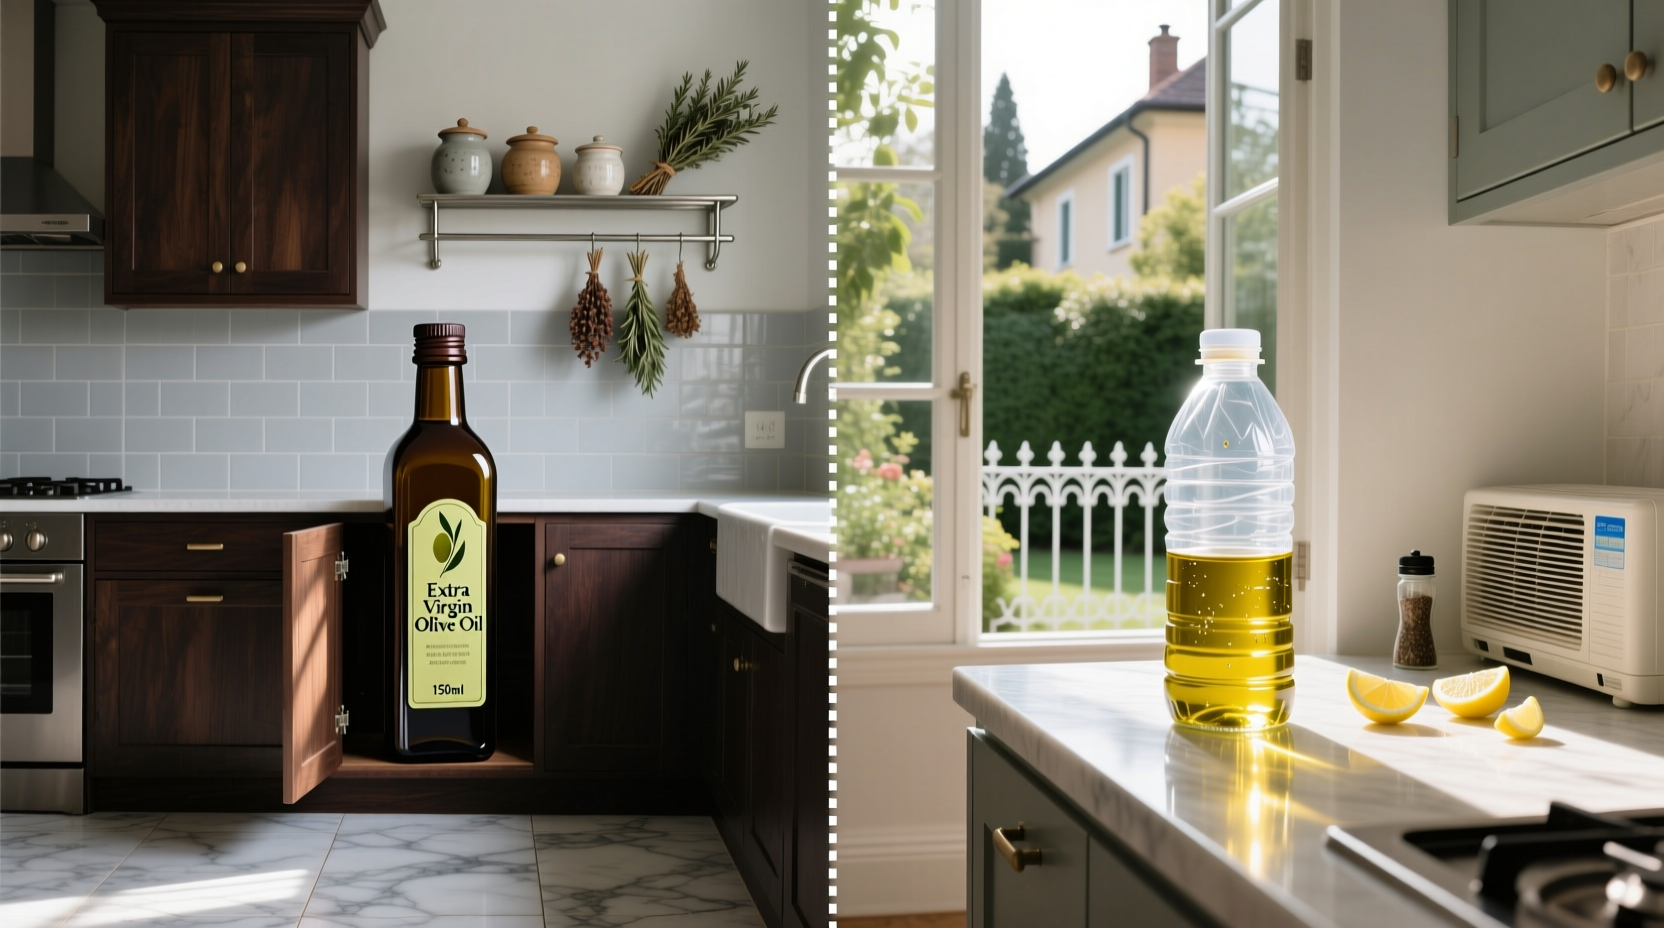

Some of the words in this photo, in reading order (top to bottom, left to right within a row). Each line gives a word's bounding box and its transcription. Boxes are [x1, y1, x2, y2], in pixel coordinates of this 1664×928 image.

[427, 582, 470, 598] Extra
[423, 599, 473, 619] Virgin
[414, 616, 456, 632] Olive
[459, 615, 483, 632] Oil
[432, 683, 464, 696] 150ml
